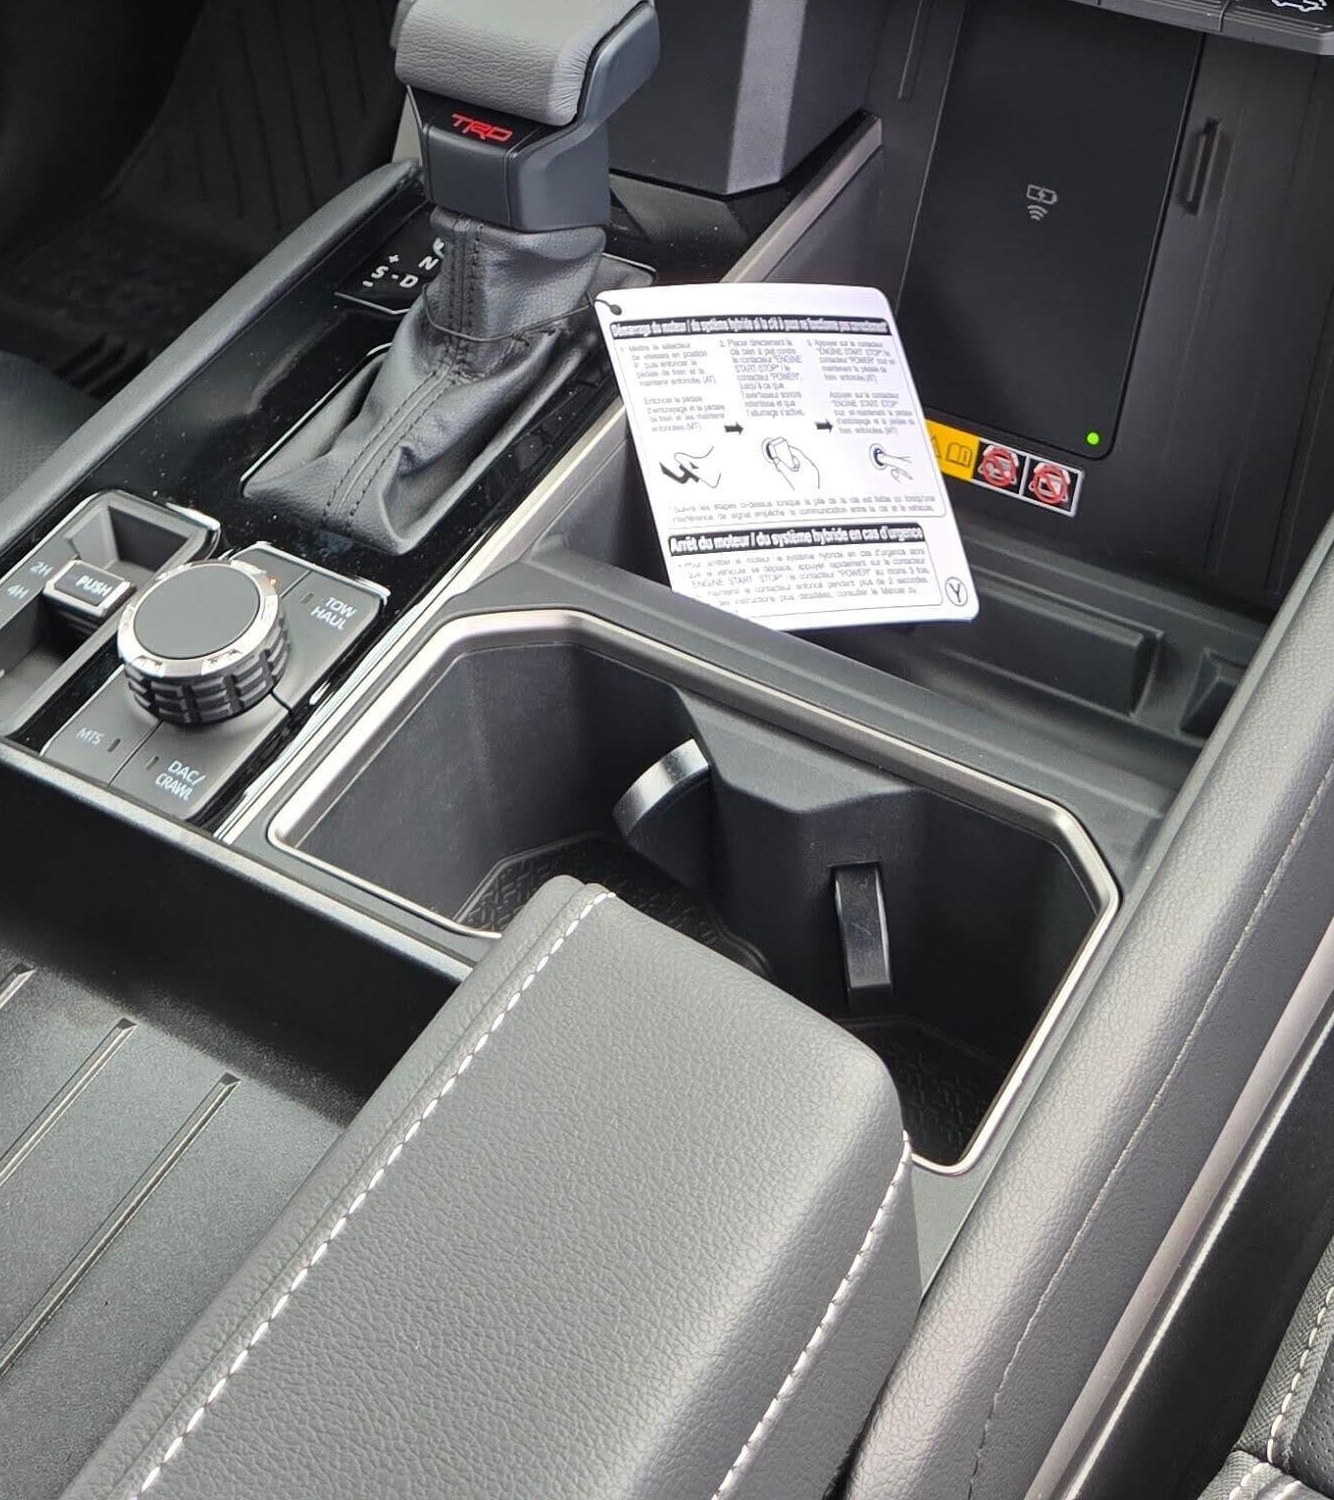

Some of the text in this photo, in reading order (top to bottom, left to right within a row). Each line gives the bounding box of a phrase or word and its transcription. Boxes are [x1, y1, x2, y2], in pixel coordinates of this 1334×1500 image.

[451, 113, 513, 142] TRD
[371, 265, 389, 279] S
[419, 256, 439, 270] N
[399, 275, 418, 288] D
[670, 535, 698, 553] Arrêt
[698, 535, 713, 551] du
[713, 533, 749, 549] moteur
[756, 531, 771, 546] du
[771, 528, 812, 548] système
[811, 528, 849, 545] hybride
[849, 528, 862, 540] en
[862, 528, 879, 540] cas
[29, 561, 54, 577] 2H
[6, 583, 29, 600] 4H
[75, 575, 114, 597] PUSH
[949, 583, 961, 603] Y
[325, 596, 357, 618] TOW
[310, 606, 347, 631] HAUL
[76, 727, 105, 745] MTS
[167, 760, 207, 785] DAC/
[155, 773, 194, 800] CRAWL
